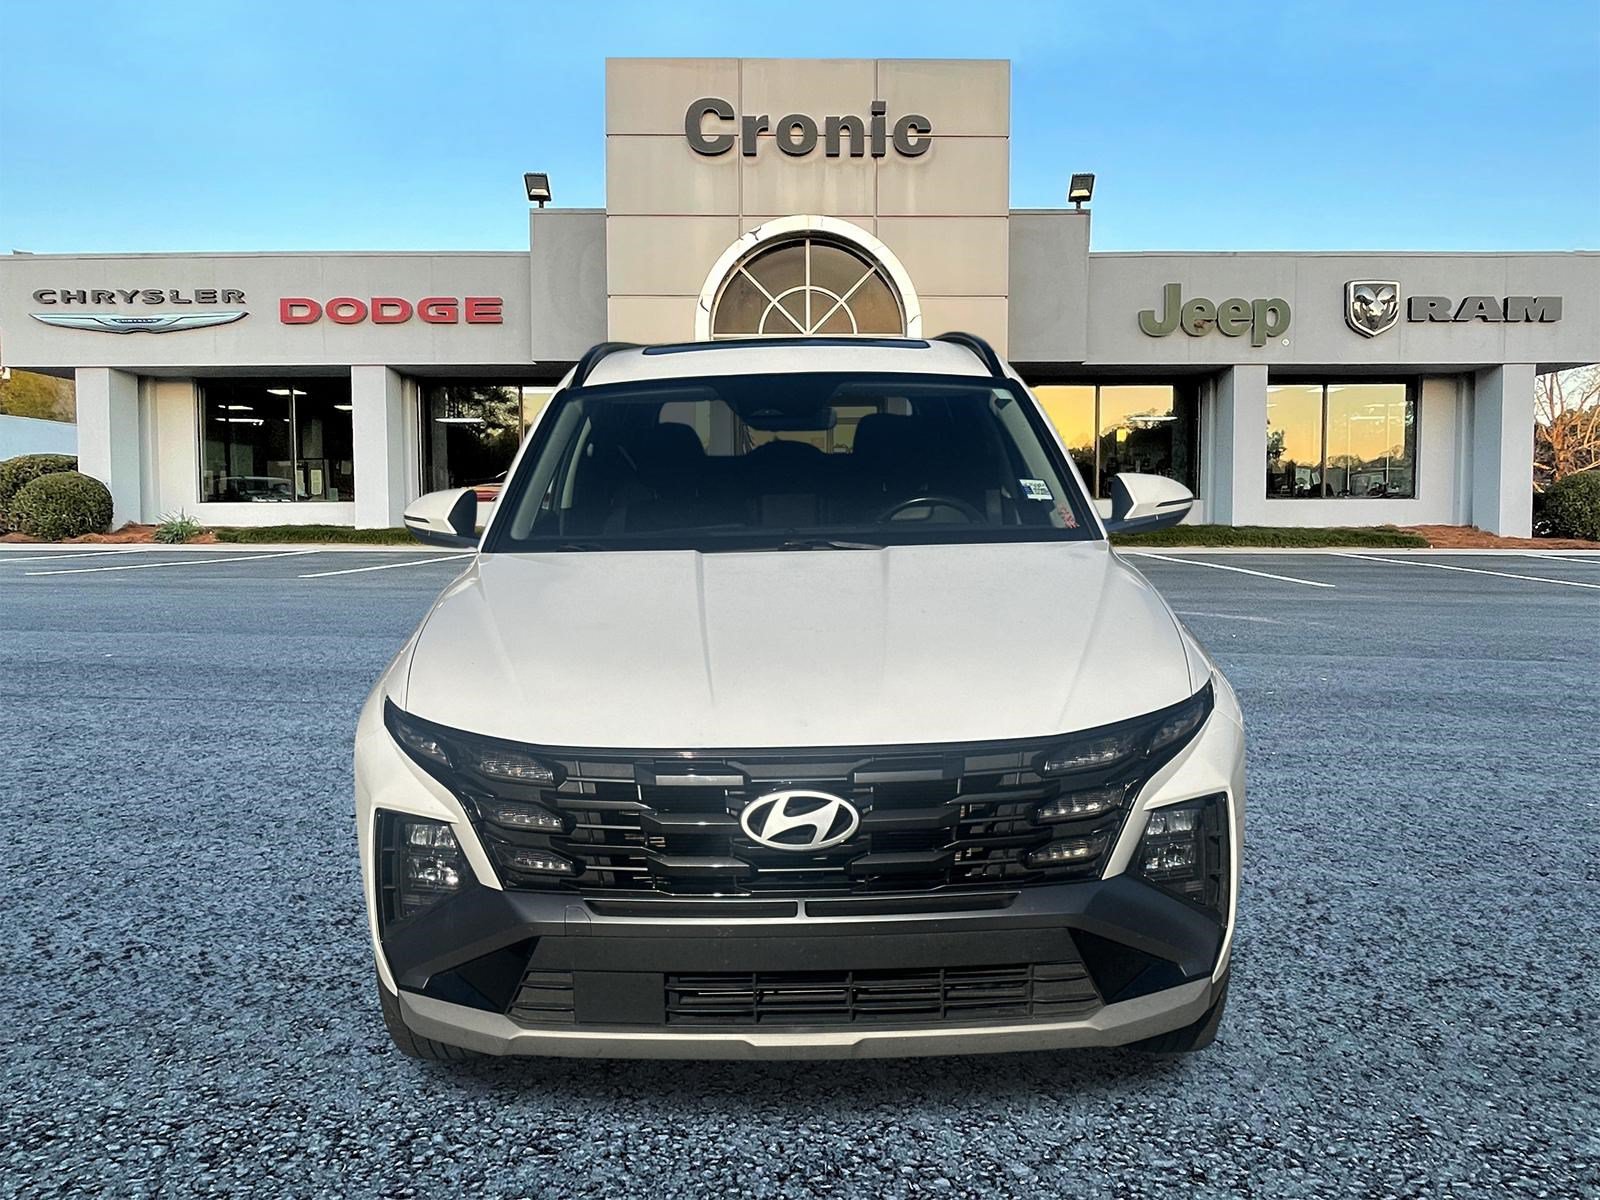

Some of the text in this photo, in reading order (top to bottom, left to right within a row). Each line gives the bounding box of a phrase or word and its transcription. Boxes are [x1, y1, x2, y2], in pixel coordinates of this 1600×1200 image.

[685, 97, 932, 157] Cronic
[32, 288, 247, 304] CHRYSLER
[279, 296, 503, 324] DODGE
[1407, 295, 1563, 322] RAM
[1138, 283, 1291, 347] Jeep
